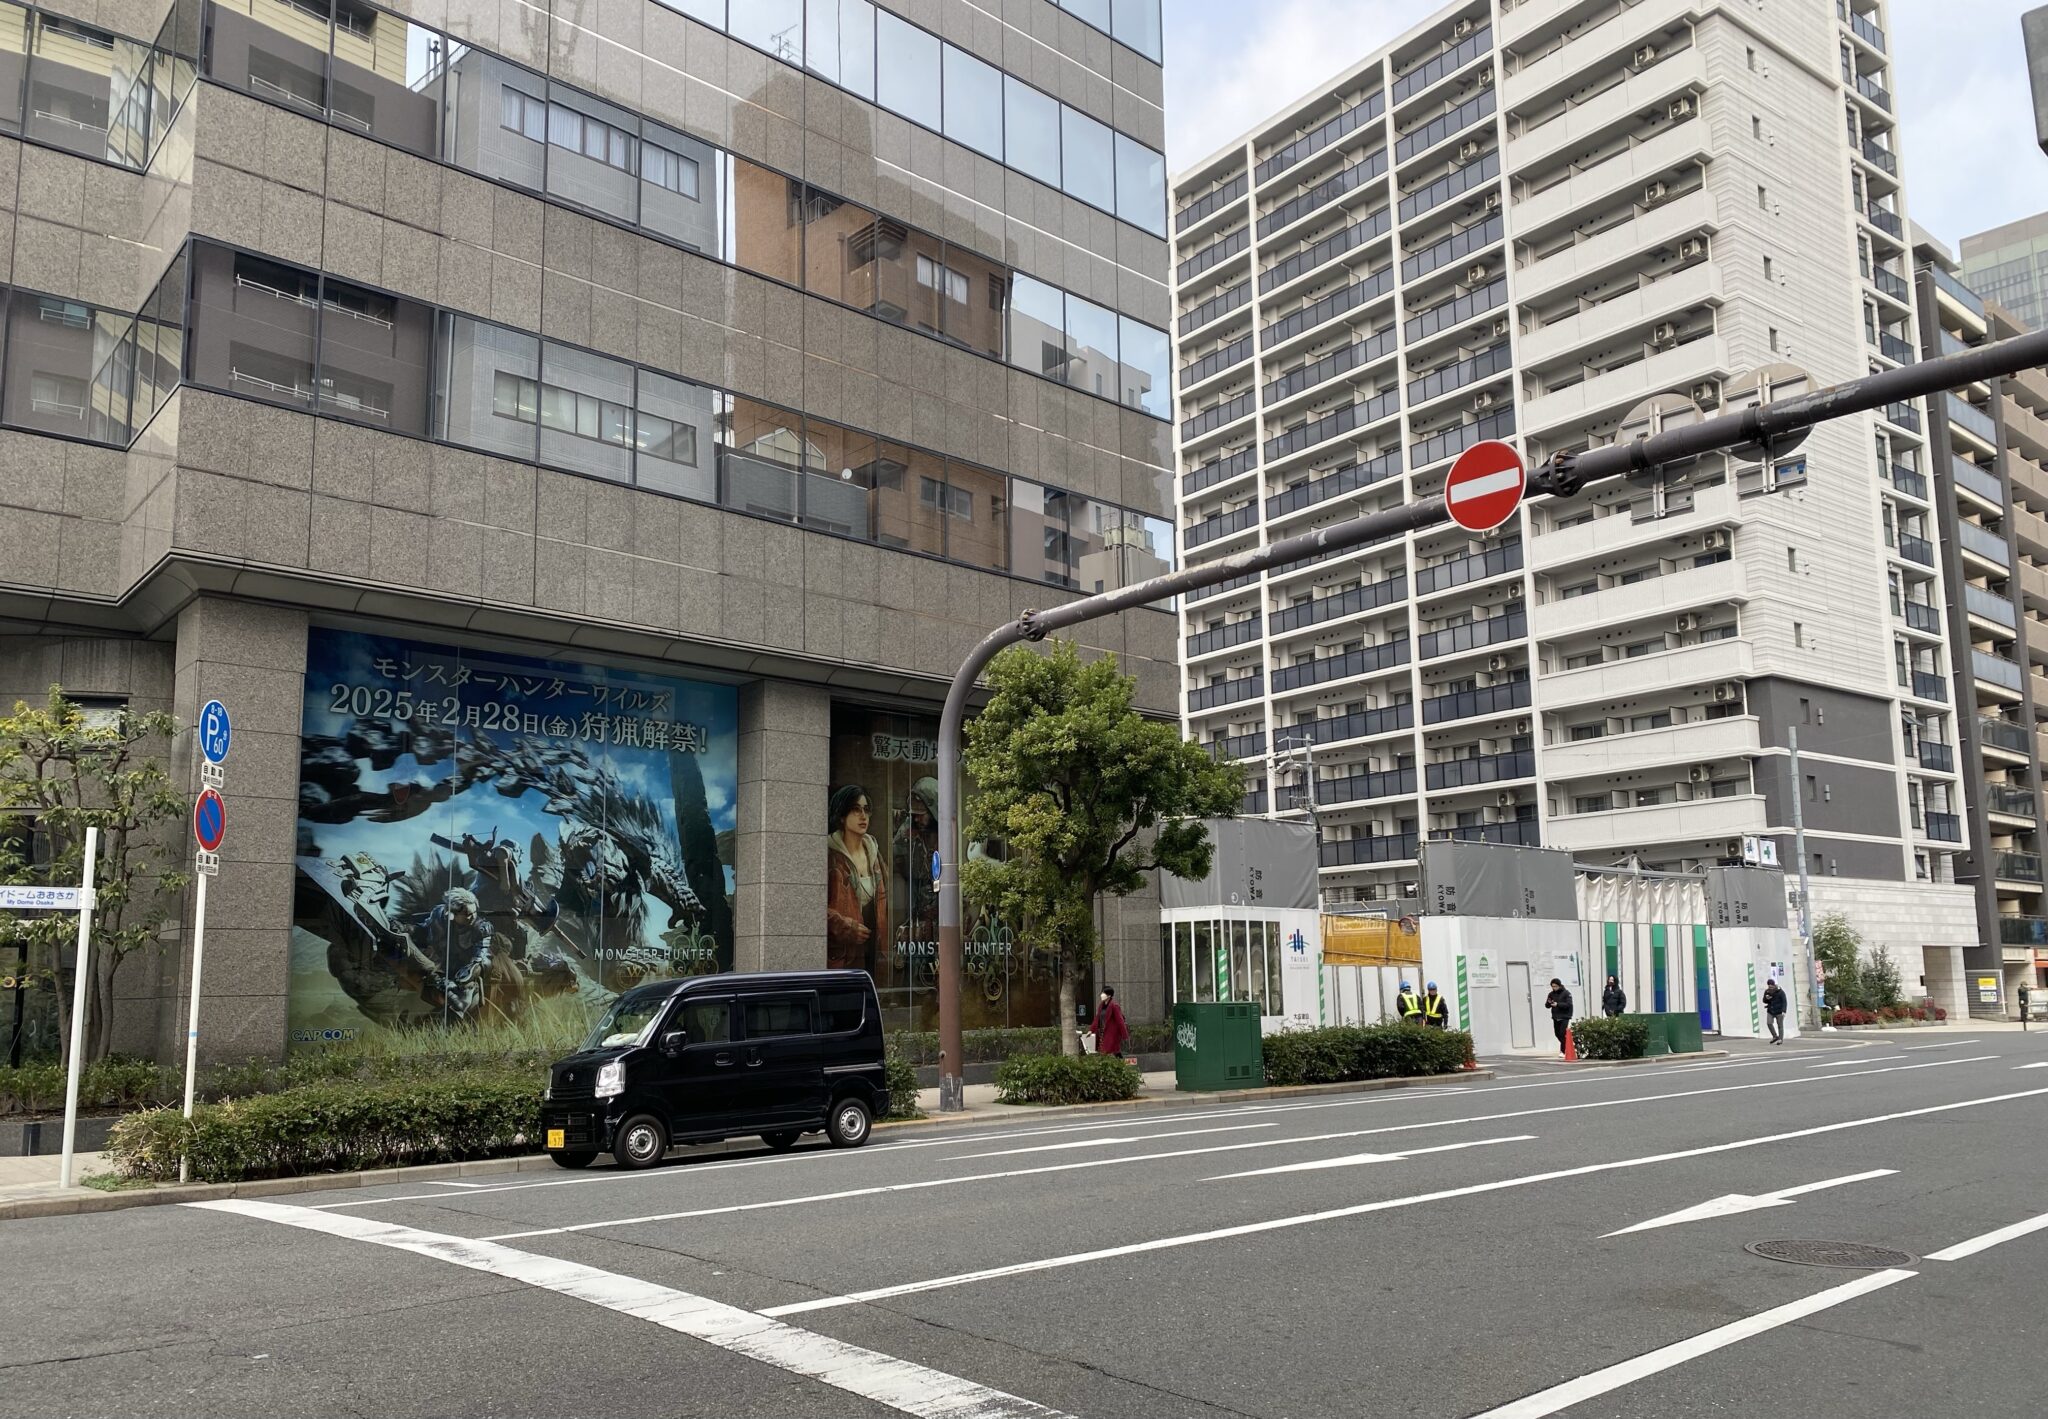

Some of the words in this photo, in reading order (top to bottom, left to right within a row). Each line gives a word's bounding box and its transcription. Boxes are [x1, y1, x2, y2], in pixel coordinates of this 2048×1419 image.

[373, 657, 671, 713] モンスターハンターワイルズ
[205, 713, 220, 751] P
[1437, 884, 1446, 914] KYOWA
[1445, 886, 1456, 912] 防音
[594, 948, 658, 960] MONSTER
[663, 949, 713, 960] HUNTER
[897, 941, 940, 955] MONS
[964, 942, 1012, 955] HUNTER
[291, 1028, 355, 1041] CAPCOM
